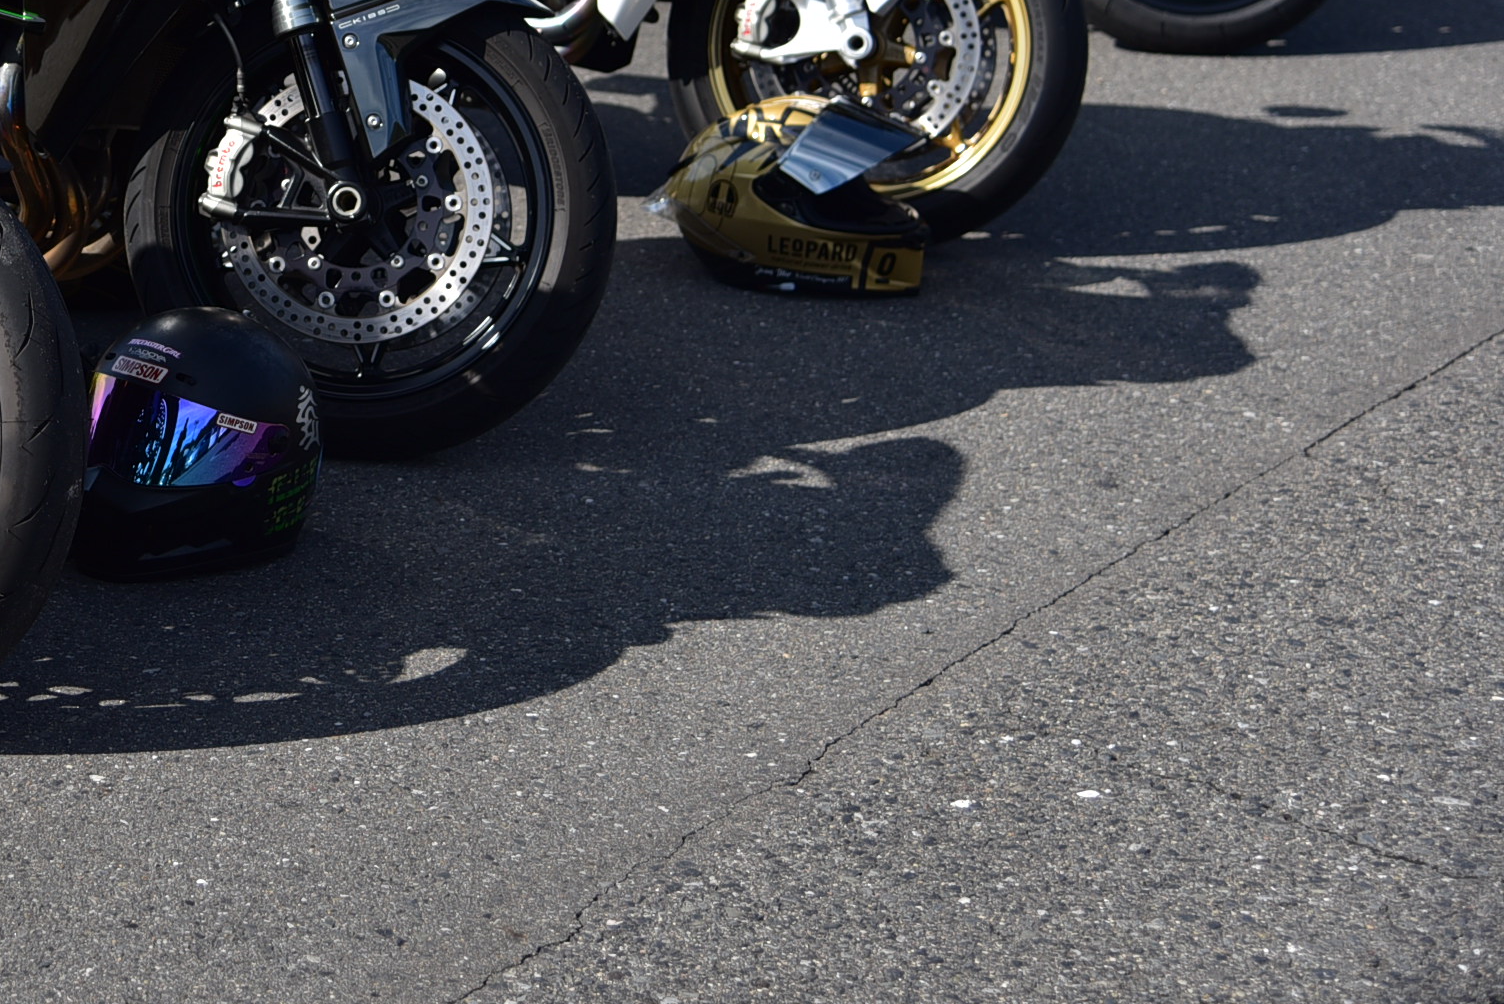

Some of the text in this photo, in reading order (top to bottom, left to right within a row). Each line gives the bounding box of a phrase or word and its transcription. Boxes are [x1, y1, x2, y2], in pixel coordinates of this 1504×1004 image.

[213, 141, 235, 188] brembo
[767, 235, 858, 262] LEOPARD
[114, 357, 164, 382] SIMPSON
[218, 415, 255, 432] SIMPSON
